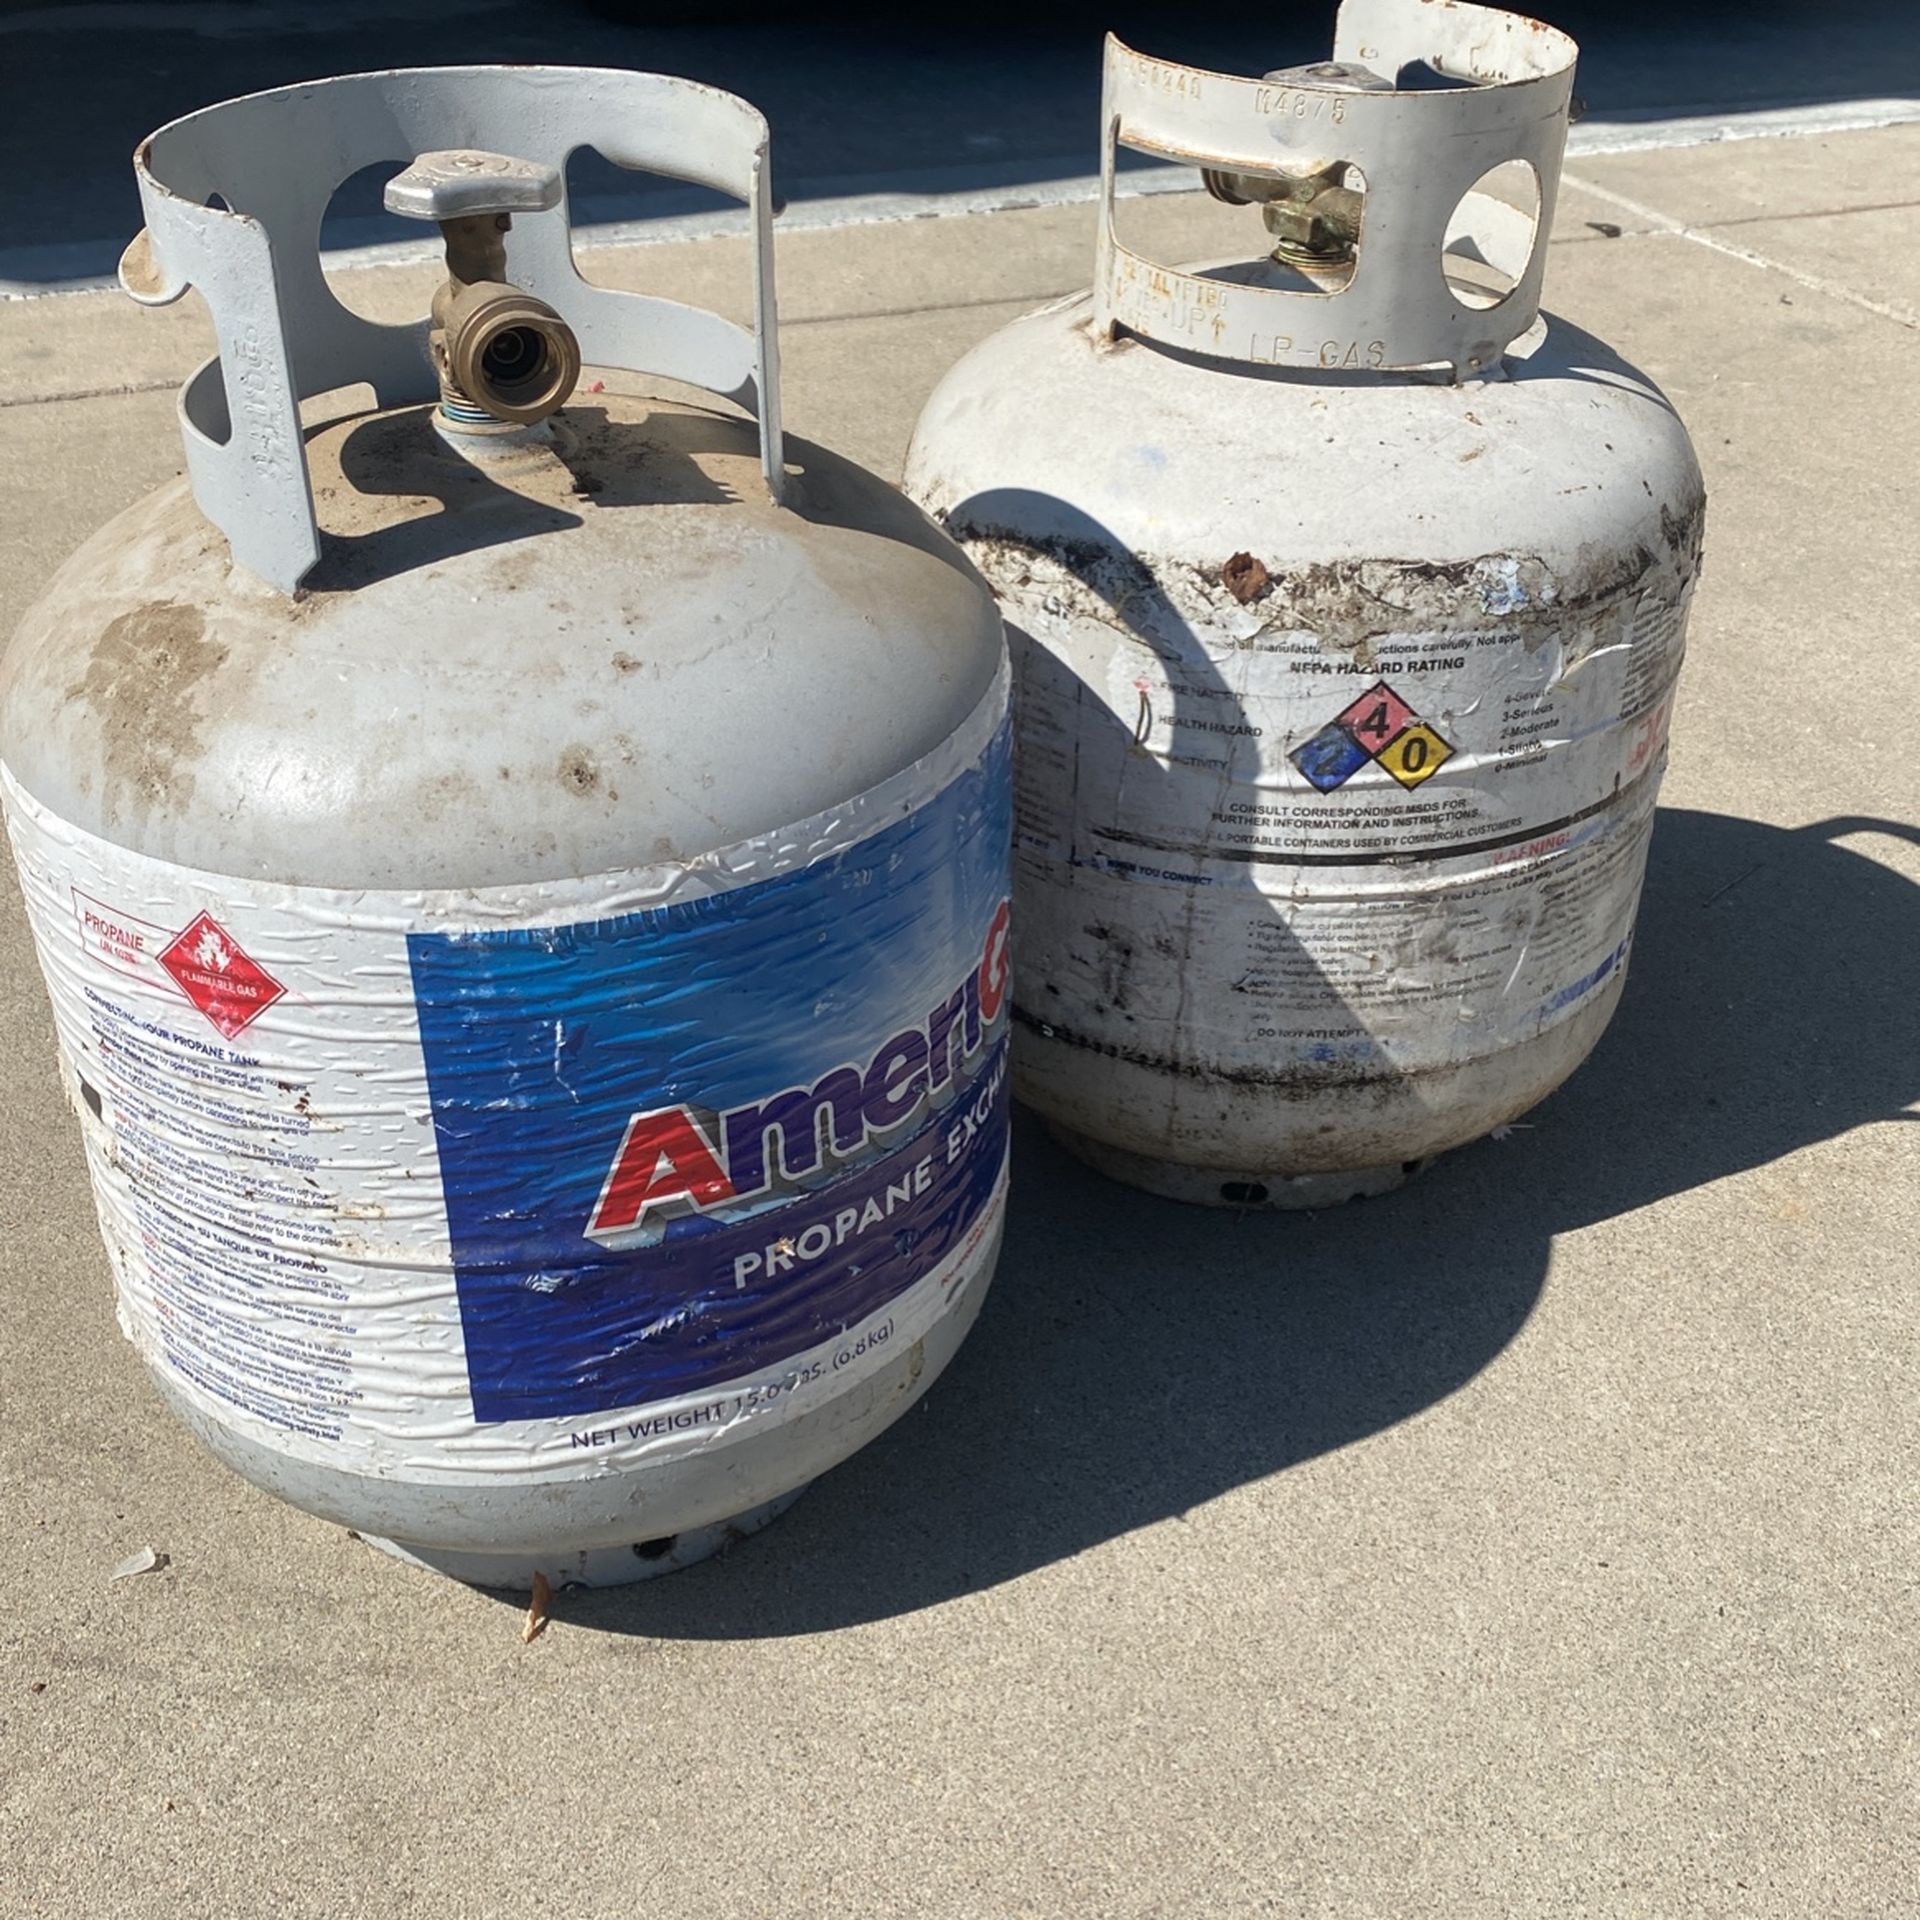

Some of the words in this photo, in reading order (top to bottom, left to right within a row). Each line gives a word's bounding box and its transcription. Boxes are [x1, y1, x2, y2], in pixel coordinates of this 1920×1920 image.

[1249, 332, 1386, 369] LP-GAS
[1475, 635, 1496, 648] Not
[1336, 659, 1402, 675] HAZARD
[1406, 656, 1465, 673] RATING
[1360, 701, 1391, 739] 4
[1502, 703, 1554, 723] 3-Serious
[1159, 714, 1207, 732] HEALTH
[1209, 722, 1262, 738] HAZARD
[1500, 718, 1560, 739] 2-Moderate
[1312, 737, 1345, 777] 2
[1401, 736, 1429, 774] 0
[1494, 752, 1549, 773] 0-Minimal
[1229, 802, 1290, 817] CONSULT
[1291, 805, 1402, 818] CORRESPONDING
[1405, 801, 1439, 813] MSDS
[1441, 798, 1467, 810] FOR
[1211, 812, 1271, 828] FURTHER
[1273, 819, 1361, 830] INFORMATION
[1361, 818, 1390, 829] AND
[1226, 833, 1283, 848] PORTABLE
[1284, 837, 1351, 849] CONTAINERS
[1352, 837, 1381, 849] USED
[1382, 836, 1399, 847] BY
[1400, 829, 1465, 846] COMMERCIAL
[1467, 816, 1523, 838] CUSTOMERS
[1138, 865, 1161, 879] YOU
[1161, 870, 1213, 888] CONNECT
[84, 910, 144, 952] PROPANE
[236, 985, 258, 998] GAS
[1257, 1027, 1276, 1038] DO
[1306, 1028, 1361, 1040] ATTEMPT
[172, 1033, 223, 1059] PROPANE
[228, 1051, 262, 1068] TANK
[317, 1225, 332, 1235] the
[734, 1156, 934, 1289] PROPANE
[212, 1233, 252, 1254] TANQUE
[254, 1248, 269, 1260] DE
[285, 1230, 300, 1240] the
[301, 1234, 342, 1247] complete
[571, 1427, 618, 1449] NET
[627, 1402, 726, 1442] WEIGHT
[733, 1382, 781, 1410] 15.0
[783, 1360, 827, 1392] BS.
